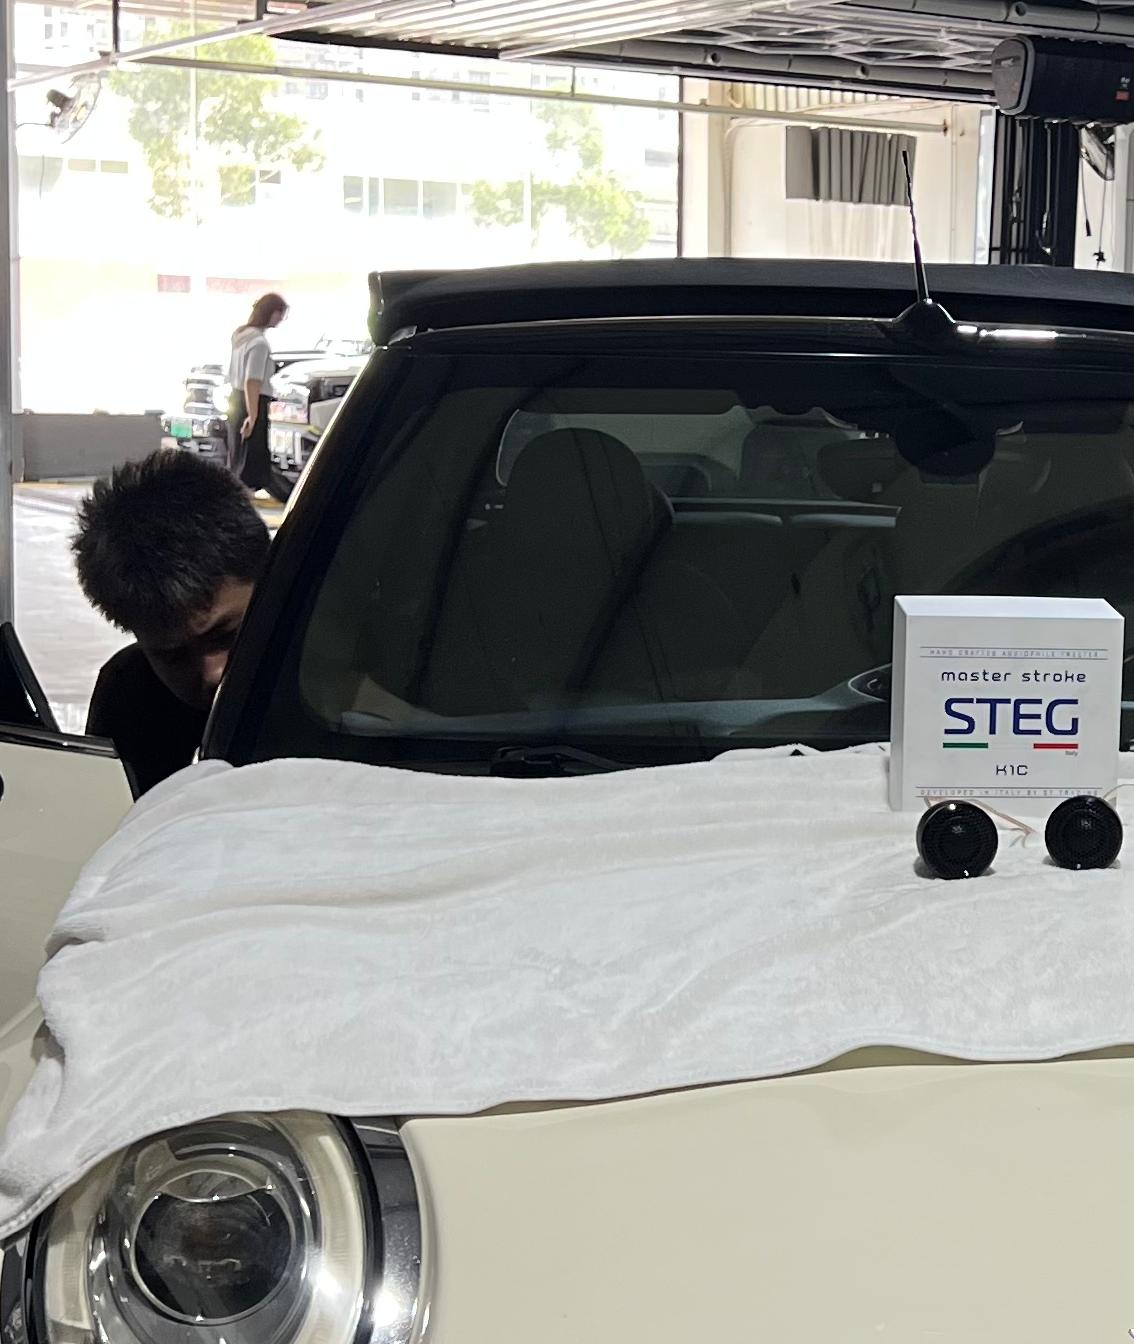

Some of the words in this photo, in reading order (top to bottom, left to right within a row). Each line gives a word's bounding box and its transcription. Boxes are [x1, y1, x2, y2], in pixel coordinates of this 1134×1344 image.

[941, 669, 1012, 682] master
[1022, 670, 1087, 683] stroke
[944, 697, 1079, 736] STEG
[995, 764, 1029, 776] K1C
